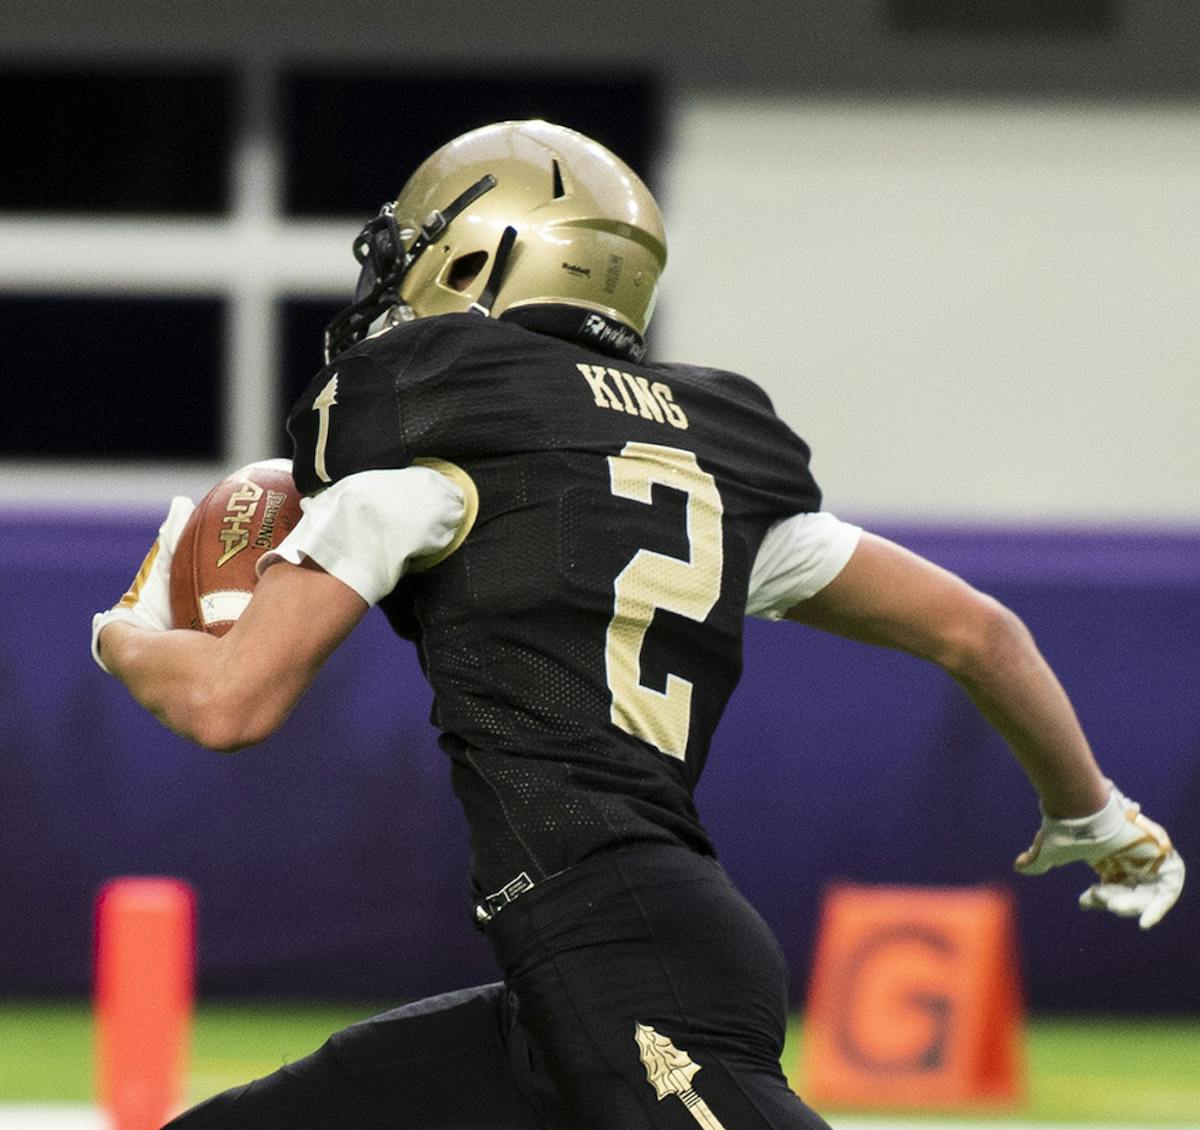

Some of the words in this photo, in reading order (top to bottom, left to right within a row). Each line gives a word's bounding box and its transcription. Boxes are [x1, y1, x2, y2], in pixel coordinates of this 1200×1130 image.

[576, 363, 689, 430] KING
[216, 477, 264, 568] ALPHA
[606, 441, 724, 762] 2
[833, 924, 957, 1077] G
